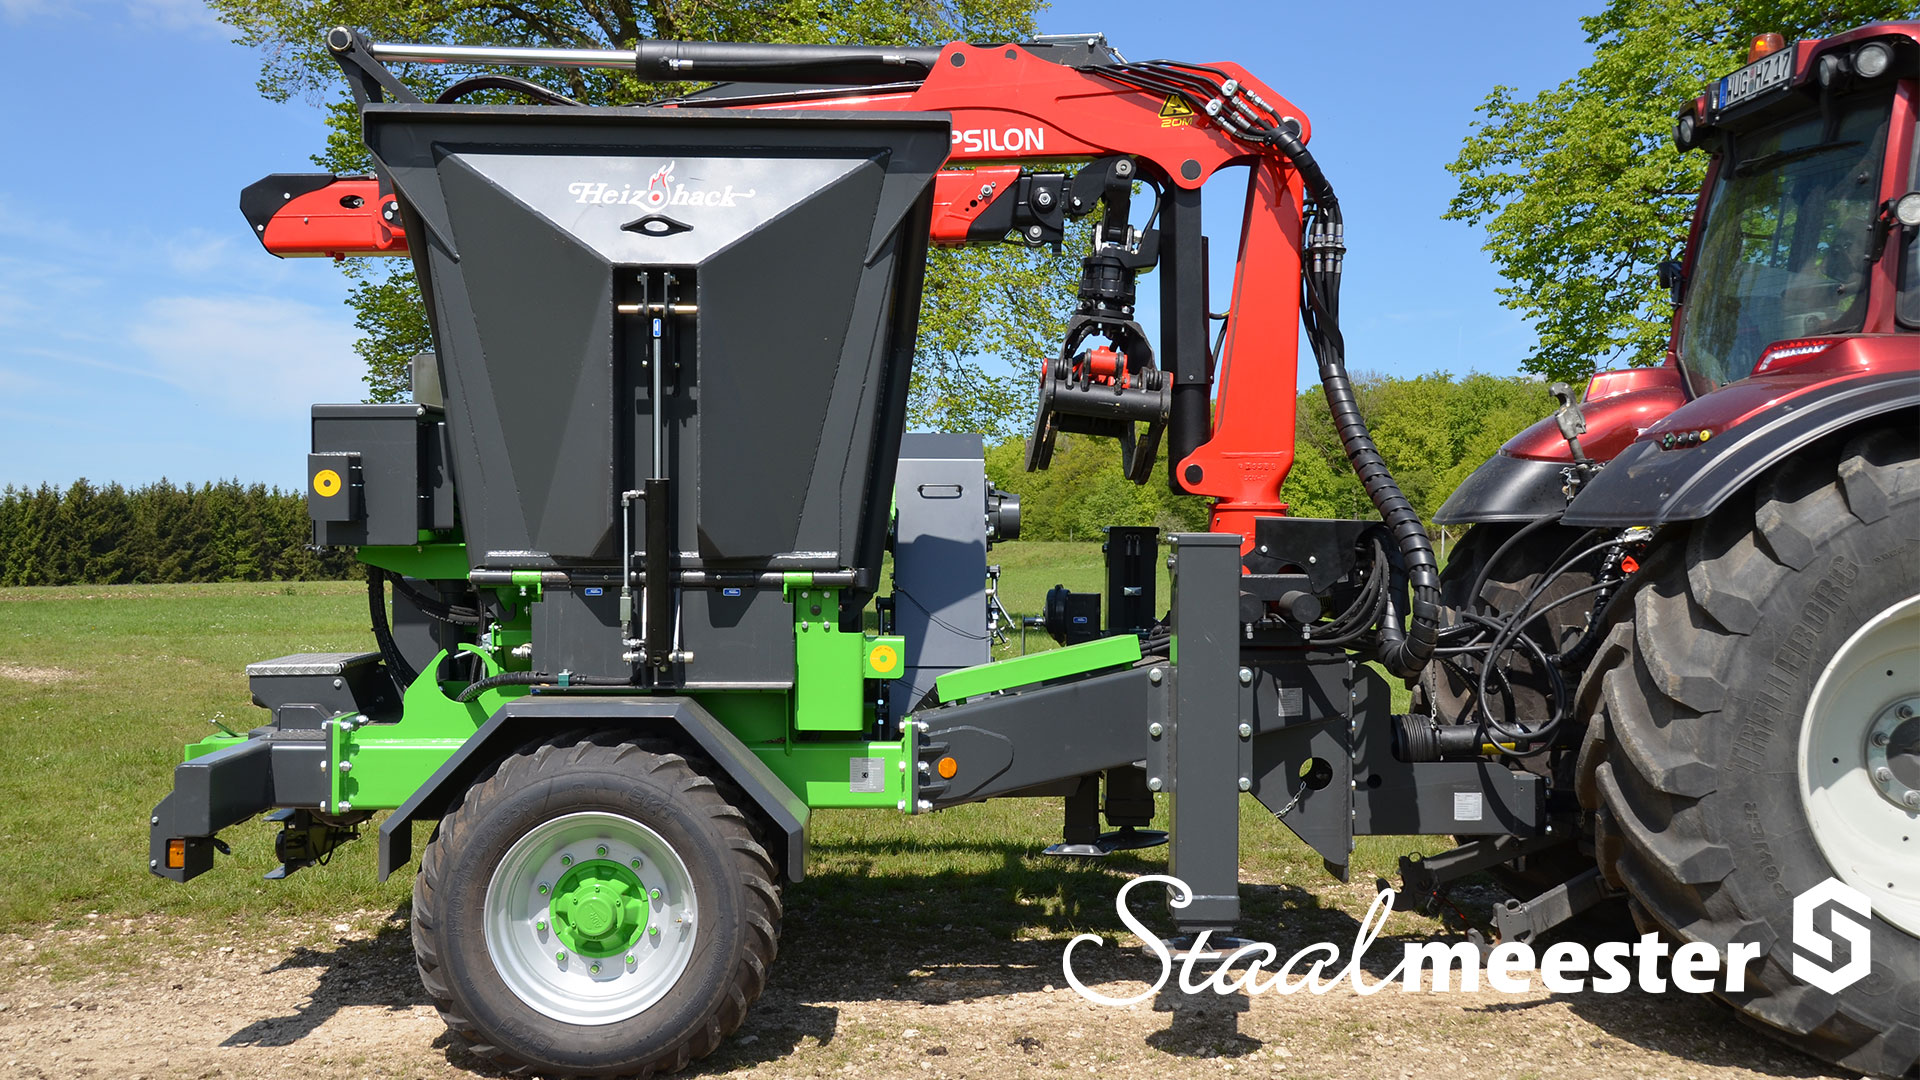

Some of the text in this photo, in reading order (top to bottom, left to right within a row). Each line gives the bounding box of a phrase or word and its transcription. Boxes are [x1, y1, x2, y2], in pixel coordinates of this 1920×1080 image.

[1755, 59, 1772, 90] HZ
[1773, 50, 1791, 81] 17
[1724, 553, 1860, 775] TRELLEBORG
